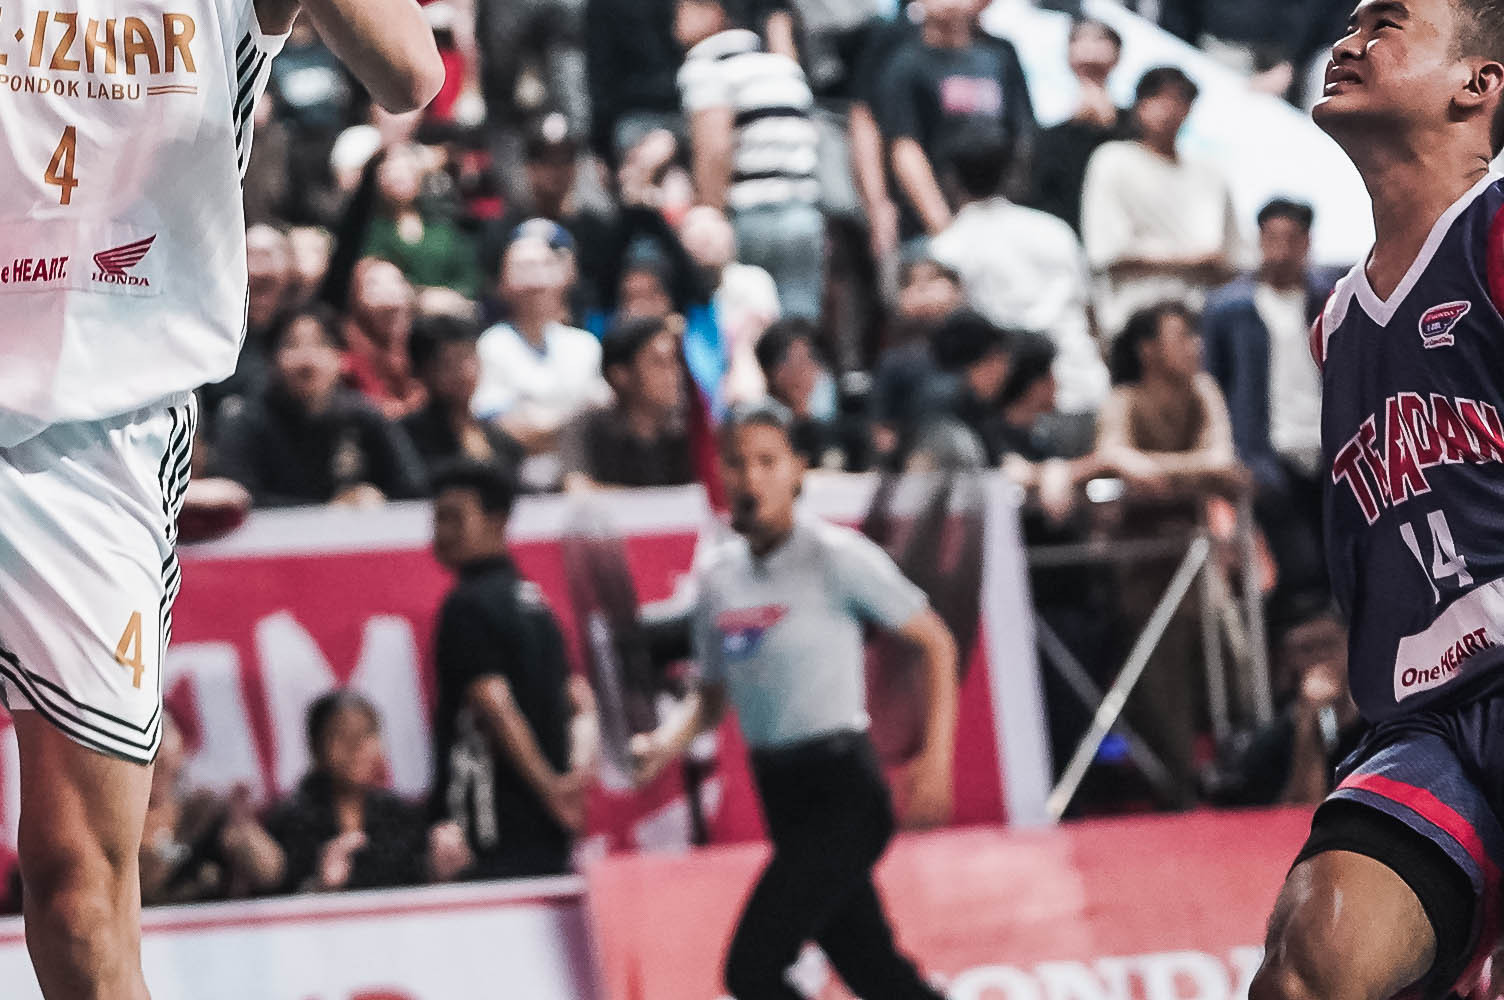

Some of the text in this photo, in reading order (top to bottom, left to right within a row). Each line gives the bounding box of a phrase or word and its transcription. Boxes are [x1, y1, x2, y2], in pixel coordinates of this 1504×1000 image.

[87, 82, 141, 101] LABU
[44, 125, 79, 205] 4
[92, 271, 150, 287] HONDA
[1399, 508, 1474, 605] 14
[114, 611, 145, 689] 4
[1401, 665, 1441, 688] One
